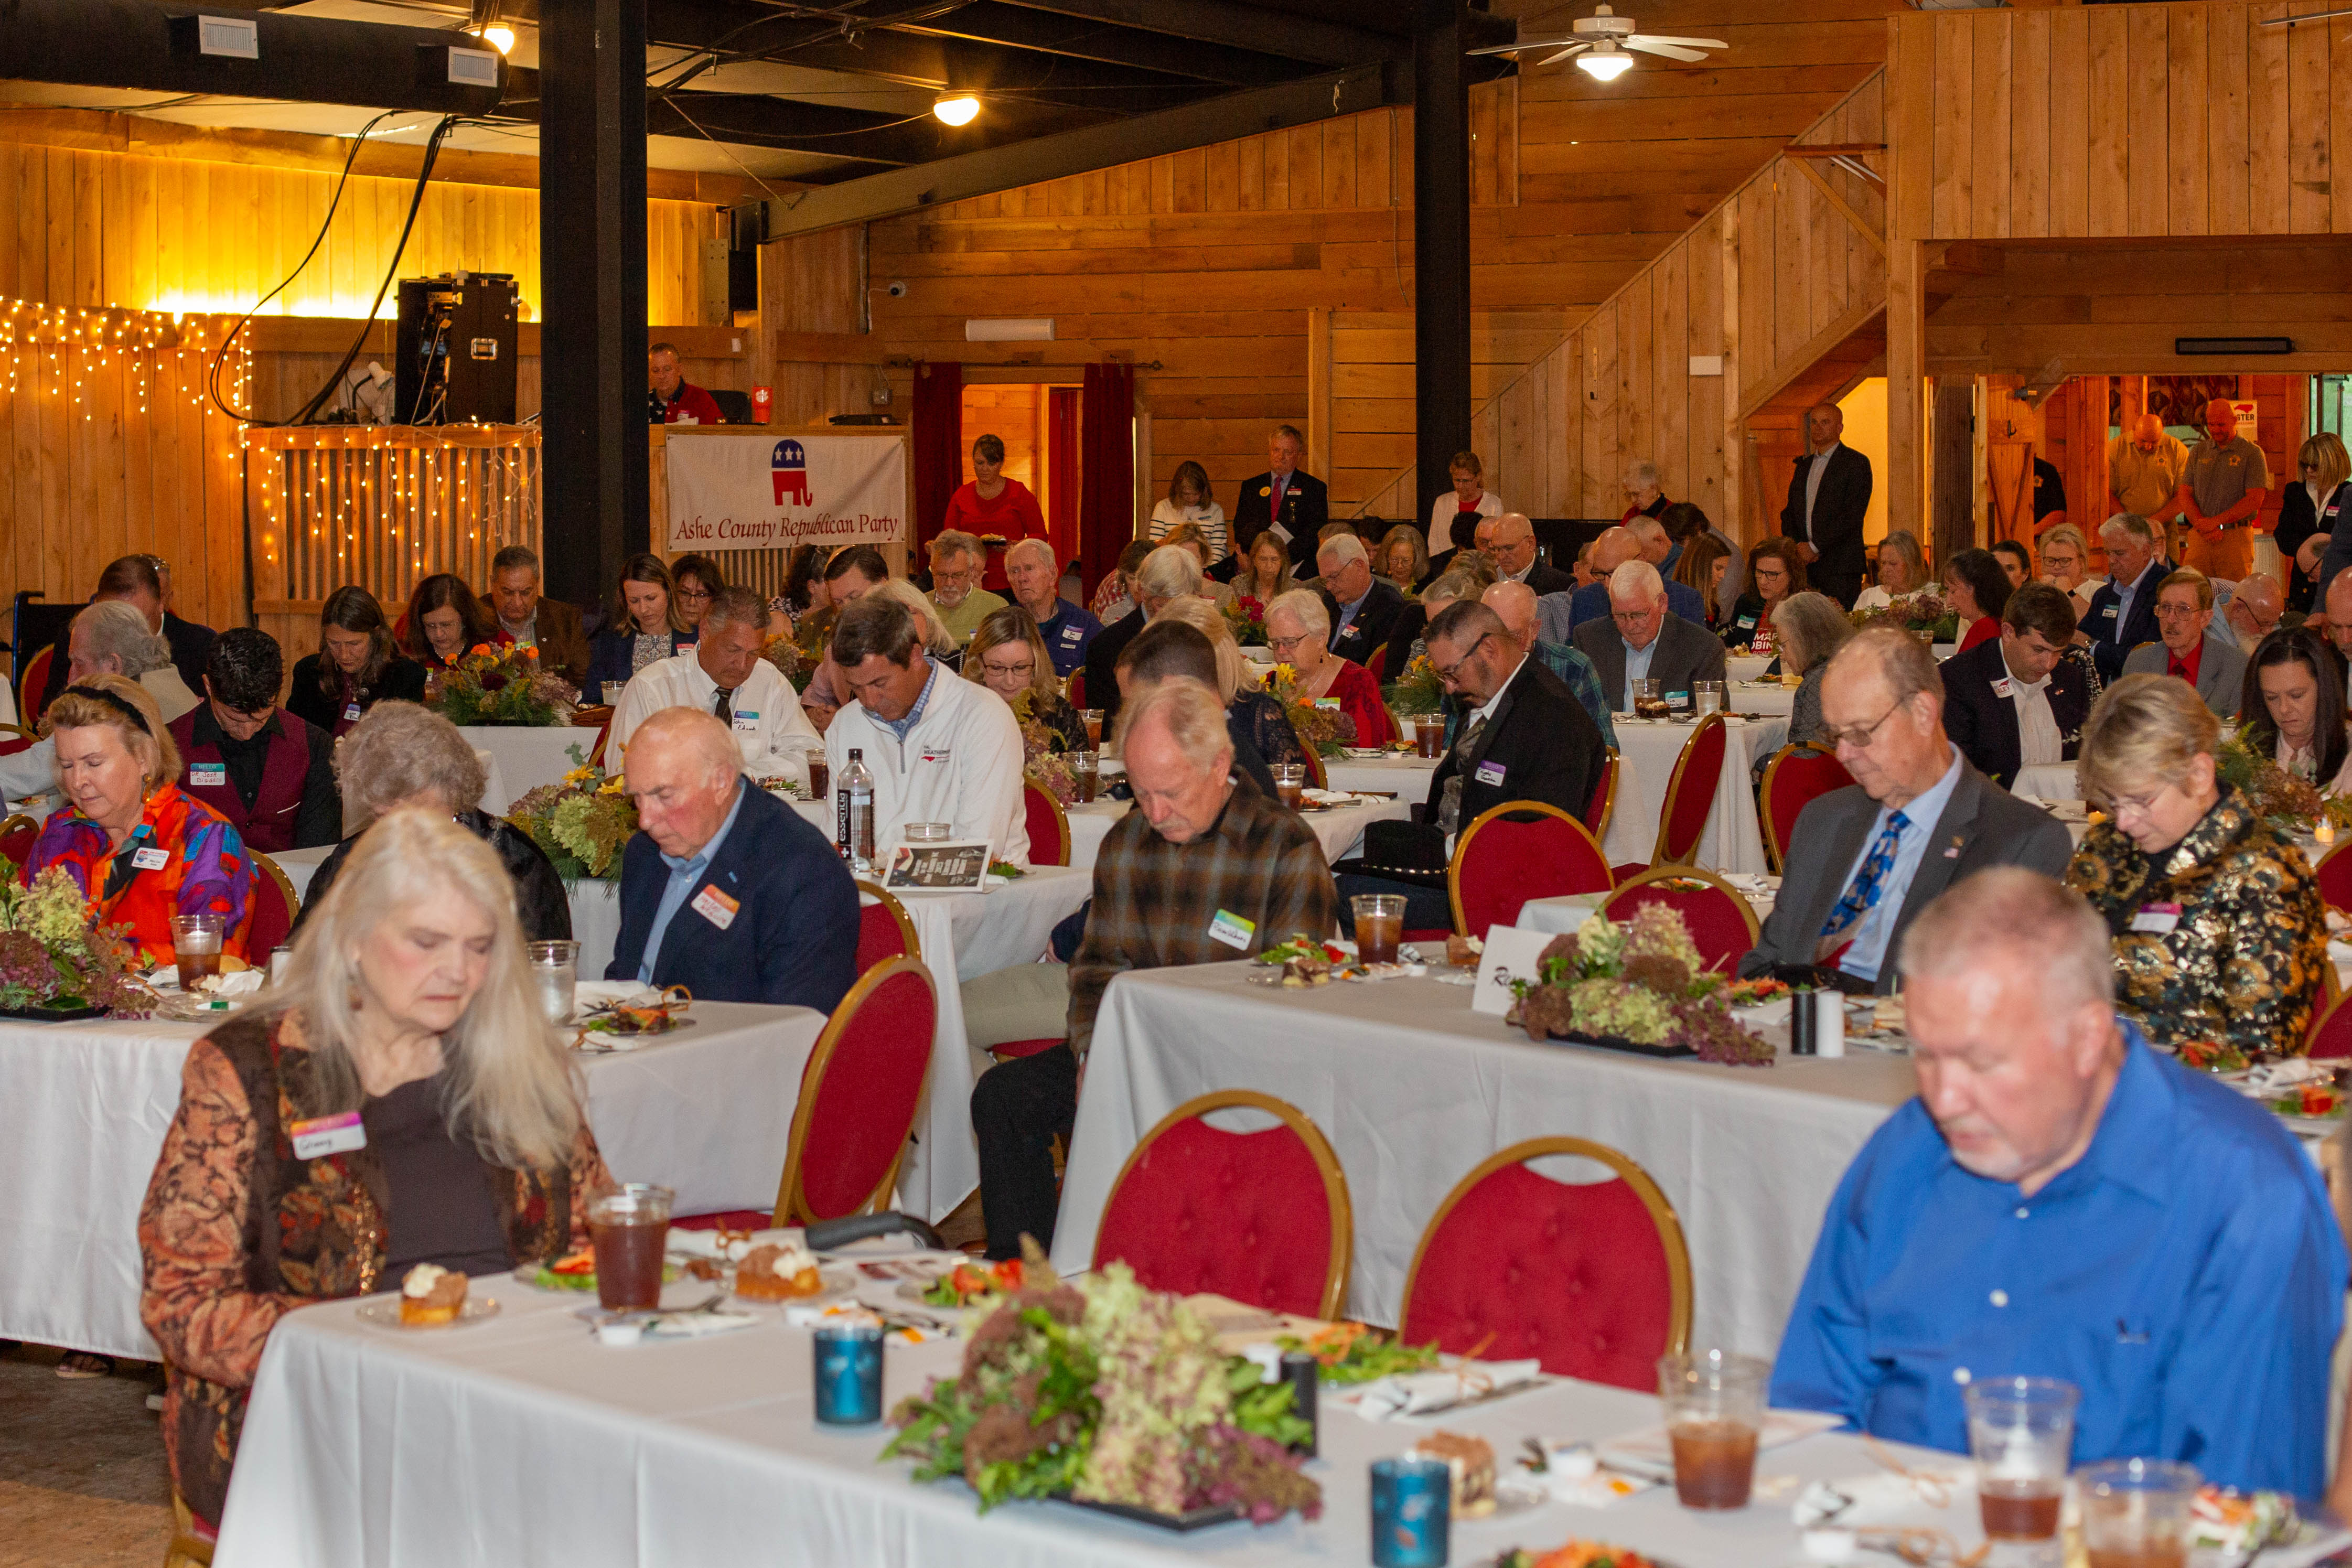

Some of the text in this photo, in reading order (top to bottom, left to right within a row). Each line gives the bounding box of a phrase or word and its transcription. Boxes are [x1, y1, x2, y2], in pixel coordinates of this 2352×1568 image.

[674, 513, 897, 546] Ashe County Republican Party
[1754, 632, 1777, 641] MAR
[1751, 641, 1773, 650] BIN
